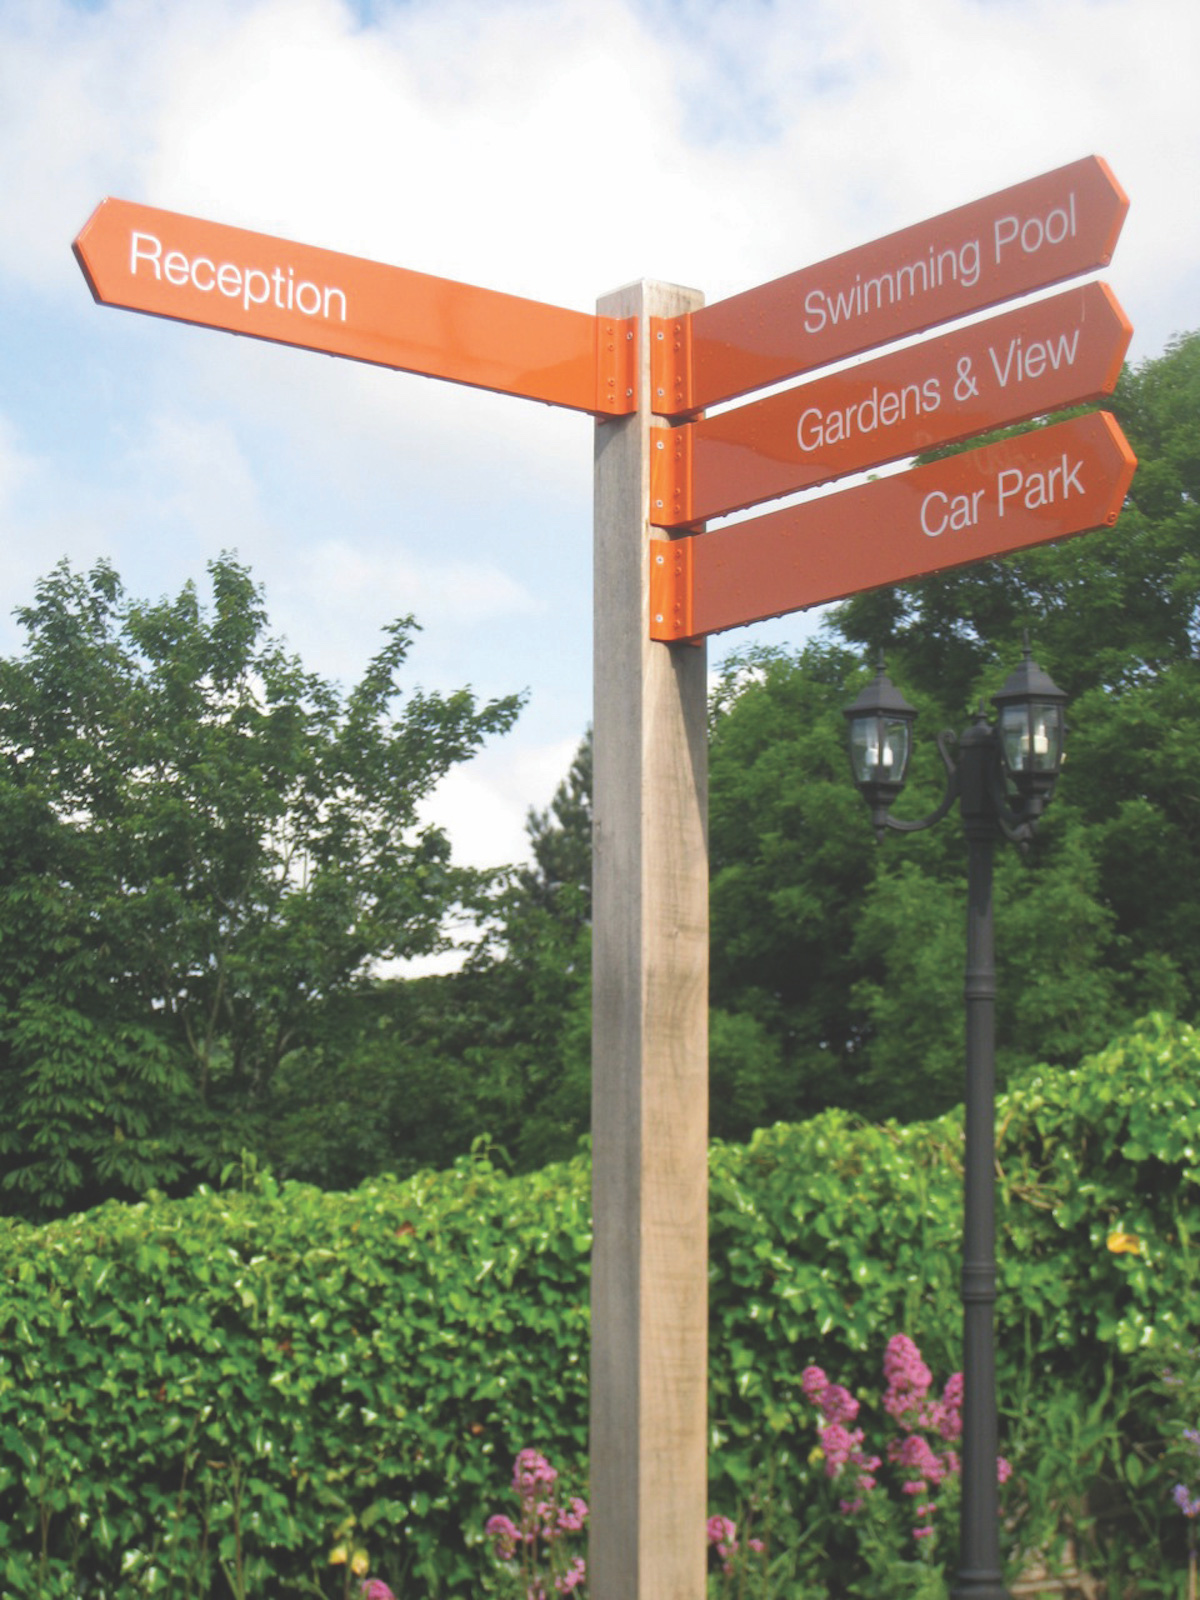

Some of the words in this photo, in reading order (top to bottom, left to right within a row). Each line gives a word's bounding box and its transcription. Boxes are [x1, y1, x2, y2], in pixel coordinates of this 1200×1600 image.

[129, 229, 348, 322] Reception
[803, 238, 981, 335] Swimming
[994, 191, 1077, 264] Pool
[796, 376, 941, 452] Gardens
[953, 356, 979, 402] &
[988, 329, 1080, 388] View
[919, 490, 985, 538] Car
[997, 453, 1086, 517] Park
